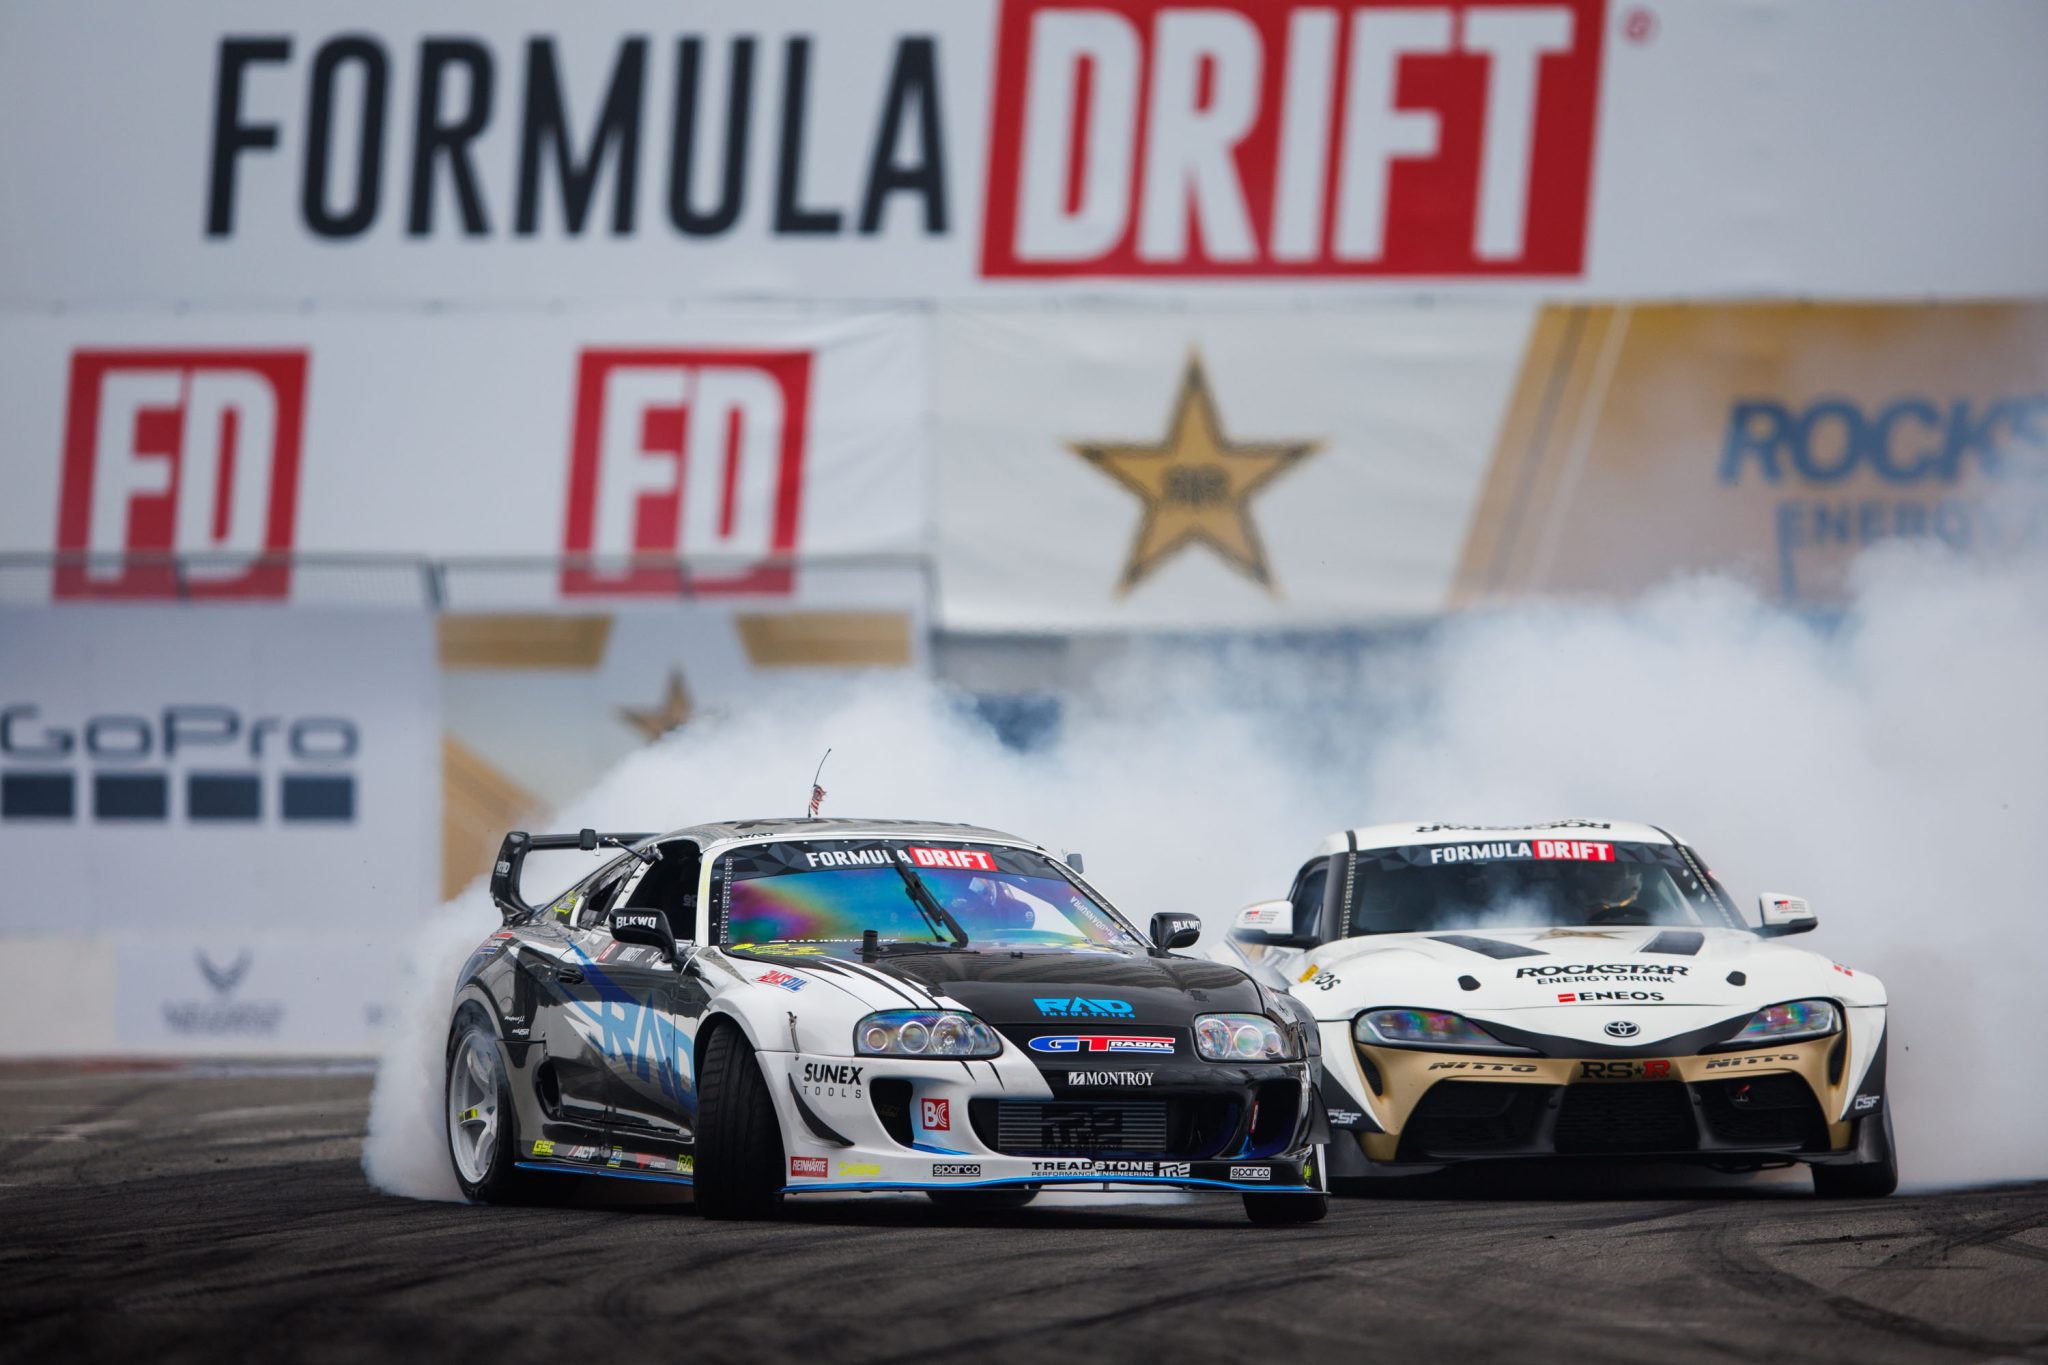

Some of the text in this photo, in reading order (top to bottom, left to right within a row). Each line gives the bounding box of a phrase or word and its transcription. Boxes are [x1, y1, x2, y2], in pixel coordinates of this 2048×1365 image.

[203, 4, 1576, 263] FORMULA DRIFT
[84, 365, 280, 586] FD
[590, 364, 786, 584] FD
[0, 705, 359, 761] GoPro
[806, 848, 990, 869] FORMULA DRIFT
[1430, 841, 1608, 864] FORMULA DRIFT
[1516, 964, 1689, 979] ROCKSTAR
[1537, 974, 1676, 985] ENERGY DRINK
[1579, 991, 1665, 1002] ENEOS
[1033, 996, 1134, 1014] RAD
[1042, 1011, 1136, 1019] INDUSTRIES
[1028, 1035, 1174, 1053] GT RADIAL
[1428, 1062, 1538, 1073] NITTO
[1704, 1054, 1800, 1070] NITTO
[803, 1063, 864, 1086] SUNEX
[1086, 1071, 1154, 1086] MONTROY
[803, 1085, 862, 1099] TOOLS
[1855, 1096, 1880, 1109] CSF
[933, 1164, 980, 1176] sparco
[1031, 1161, 1154, 1172] TREADSTONE
[1096, 1170, 1154, 1178] ENGINEERING
[1231, 1168, 1270, 1179] sparco
